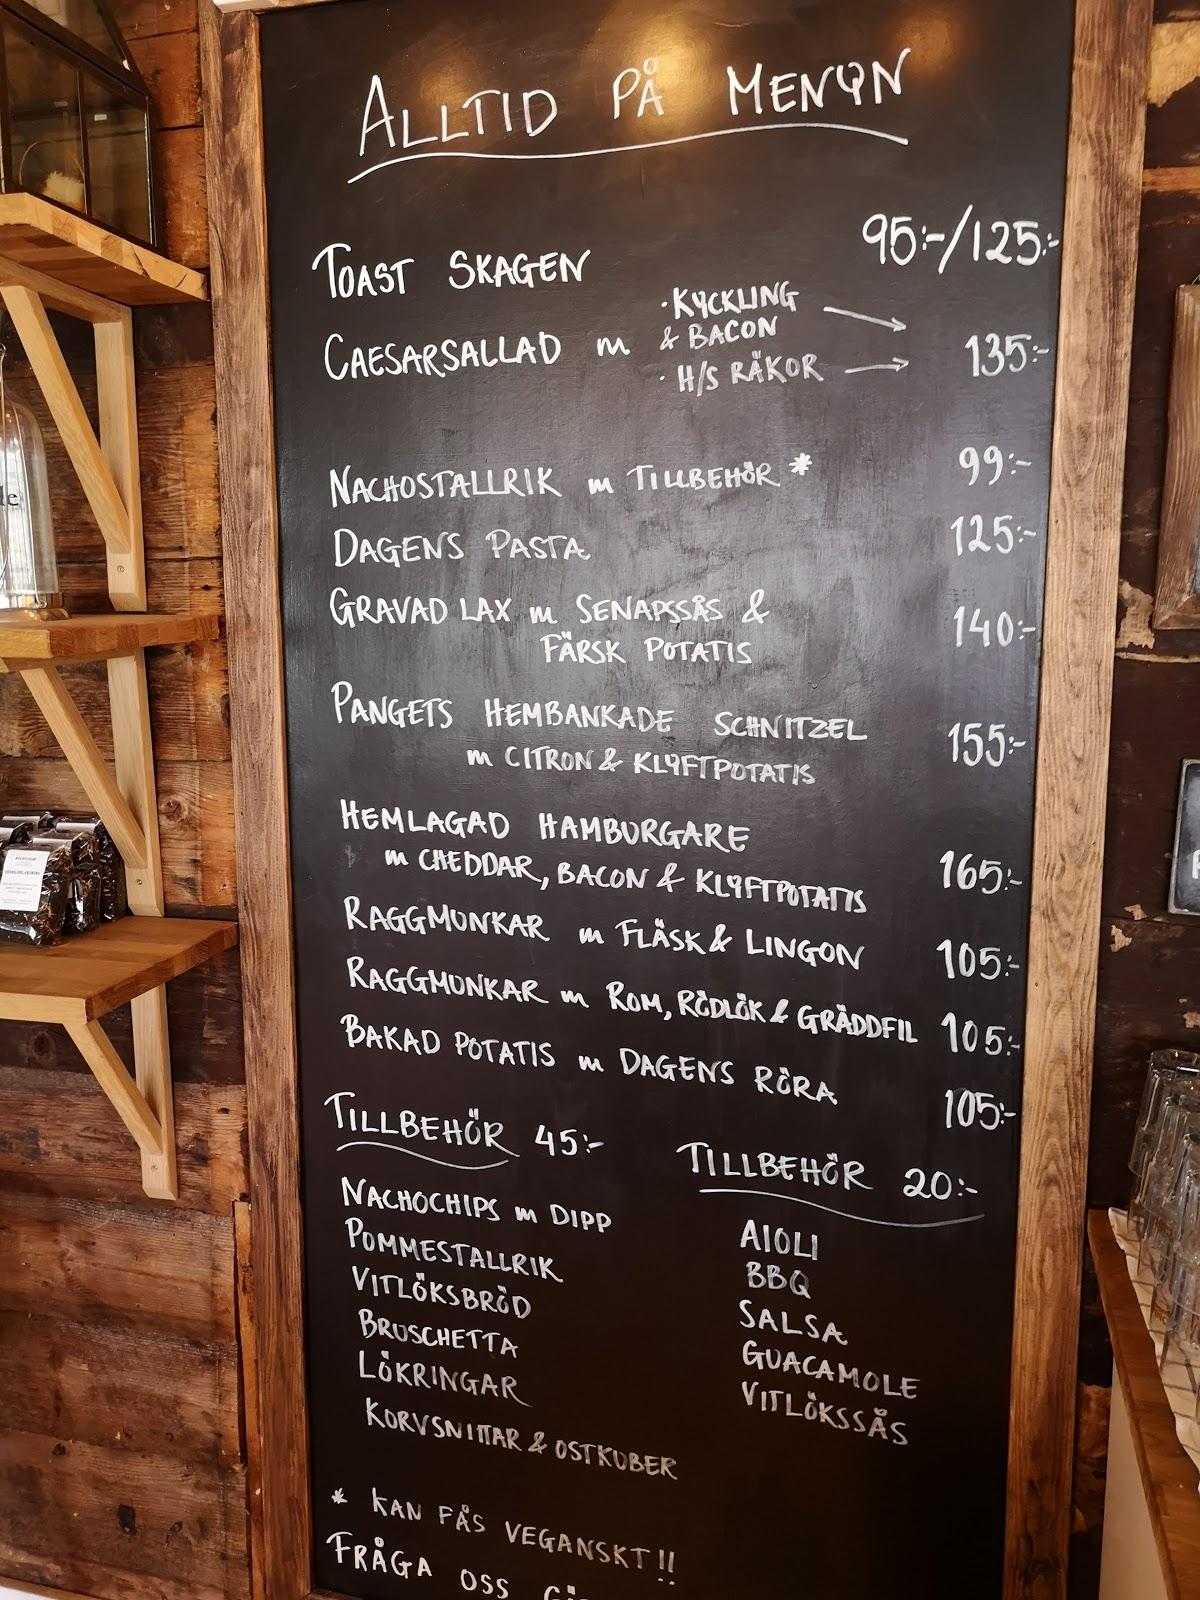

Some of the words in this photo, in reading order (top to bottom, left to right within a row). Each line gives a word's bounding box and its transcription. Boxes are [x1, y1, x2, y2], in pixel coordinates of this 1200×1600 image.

[359, 74, 560, 157] ALLTID
[613, 55, 666, 120] PÅ
[726, 47, 912, 116] MENYN
[311, 242, 415, 299] TOAST
[448, 249, 591, 290] SKAGEN
[324, 331, 562, 381] CAESARSALLAD
[596, 336, 631, 357] m
[659, 325, 679, 351] &
[687, 312, 778, 350] BACON
[964, 332, 1050, 377] 135:-
[677, 360, 719, 398] H/S
[730, 350, 825, 385] RÄKOR
[329, 464, 563, 508] NACHOSTALLRIK
[587, 477, 614, 495] m
[626, 461, 781, 491] TILLBEHÖR
[958, 445, 1032, 486] 99:-
[333, 528, 465, 568] DAGENS
[485, 528, 591, 561] PASTA
[950, 514, 1037, 557] 125:-
[329, 587, 449, 628] GRAVAD
[459, 596, 512, 624] LAX
[529, 606, 558, 624] m
[575, 593, 724, 624] SENAPSSÅS
[741, 589, 770, 624] &
[953, 605, 1036, 648] 140:-
[539, 630, 627, 665] FÄRSK
[643, 636, 753, 664] POTATIS
[330, 680, 453, 729] PANGETS
[484, 697, 675, 733] HEMBANKADE
[713, 711, 868, 741] SCHNITZEL
[466, 749, 494, 767] m
[504, 745, 595, 771] CITRON
[598, 747, 624, 772] &
[633, 751, 816, 786] KLYFTPOTATIS
[947, 722, 1026, 768] 155:-
[340, 798, 510, 840] HEMLAGAD
[538, 812, 751, 853] HAMBURGARE
[384, 849, 409, 867] m
[557, 861, 650, 889] BACON
[656, 862, 686, 893] &
[695, 868, 867, 914] KLYFTPOTATIS
[939, 850, 1023, 895] 165:-
[343, 895, 551, 942] RAGGMUNKAR
[579, 927, 605, 945] m
[614, 917, 704, 952] FLÄSK
[708, 923, 733, 953] &
[745, 928, 865, 970] LINGON
[936, 938, 1020, 980] 105:-
[346, 955, 550, 1004] RAGGMUNKAR
[560, 990, 590, 1009] m
[677, 989, 767, 1024] RÖDLÖK
[769, 998, 789, 1024] &
[797, 1003, 919, 1044] GRÄDDFIL
[940, 1011, 1021, 1056] 105:-
[339, 1013, 441, 1056] BAKAD
[454, 1031, 556, 1068] POTATIS
[578, 1055, 605, 1073] m
[619, 1047, 735, 1085] DAGENS
[754, 1065, 838, 1106] RÖRA
[323, 1091, 521, 1159] TILLBEHÖR
[534, 1127, 604, 1157] 45:-
[944, 1089, 1017, 1131] 105:-
[675, 1141, 873, 1191] TILLBEHÖR
[902, 1167, 978, 1201] 20:-
[341, 1176, 501, 1225] NACHOCHIPS
[514, 1206, 538, 1223] m
[549, 1203, 612, 1233] DIPP
[344, 1218, 565, 1285] POMMESTALLRIK
[740, 1219, 818, 1261] AIOLI
[351, 1264, 532, 1320] VITLÖKSBRÖD
[745, 1261, 811, 1300] BBQ
[358, 1308, 521, 1360] BRUSCHETTA
[739, 1300, 849, 1347] SALSA
[359, 1349, 529, 1408] LÖKRINGAR
[741, 1341, 920, 1400] GUACAMOLE
[741, 1381, 910, 1445] VITLÖKSSÅS
[365, 1397, 525, 1452] KORVSNITTAR
[527, 1431, 548, 1454] &
[554, 1439, 678, 1480] OSTKUBER
[371, 1487, 422, 1521] KAN
[438, 1504, 486, 1533] FÅS
[325, 1531, 433, 1579] FRÅGA
[460, 1568, 509, 1600] OSS
